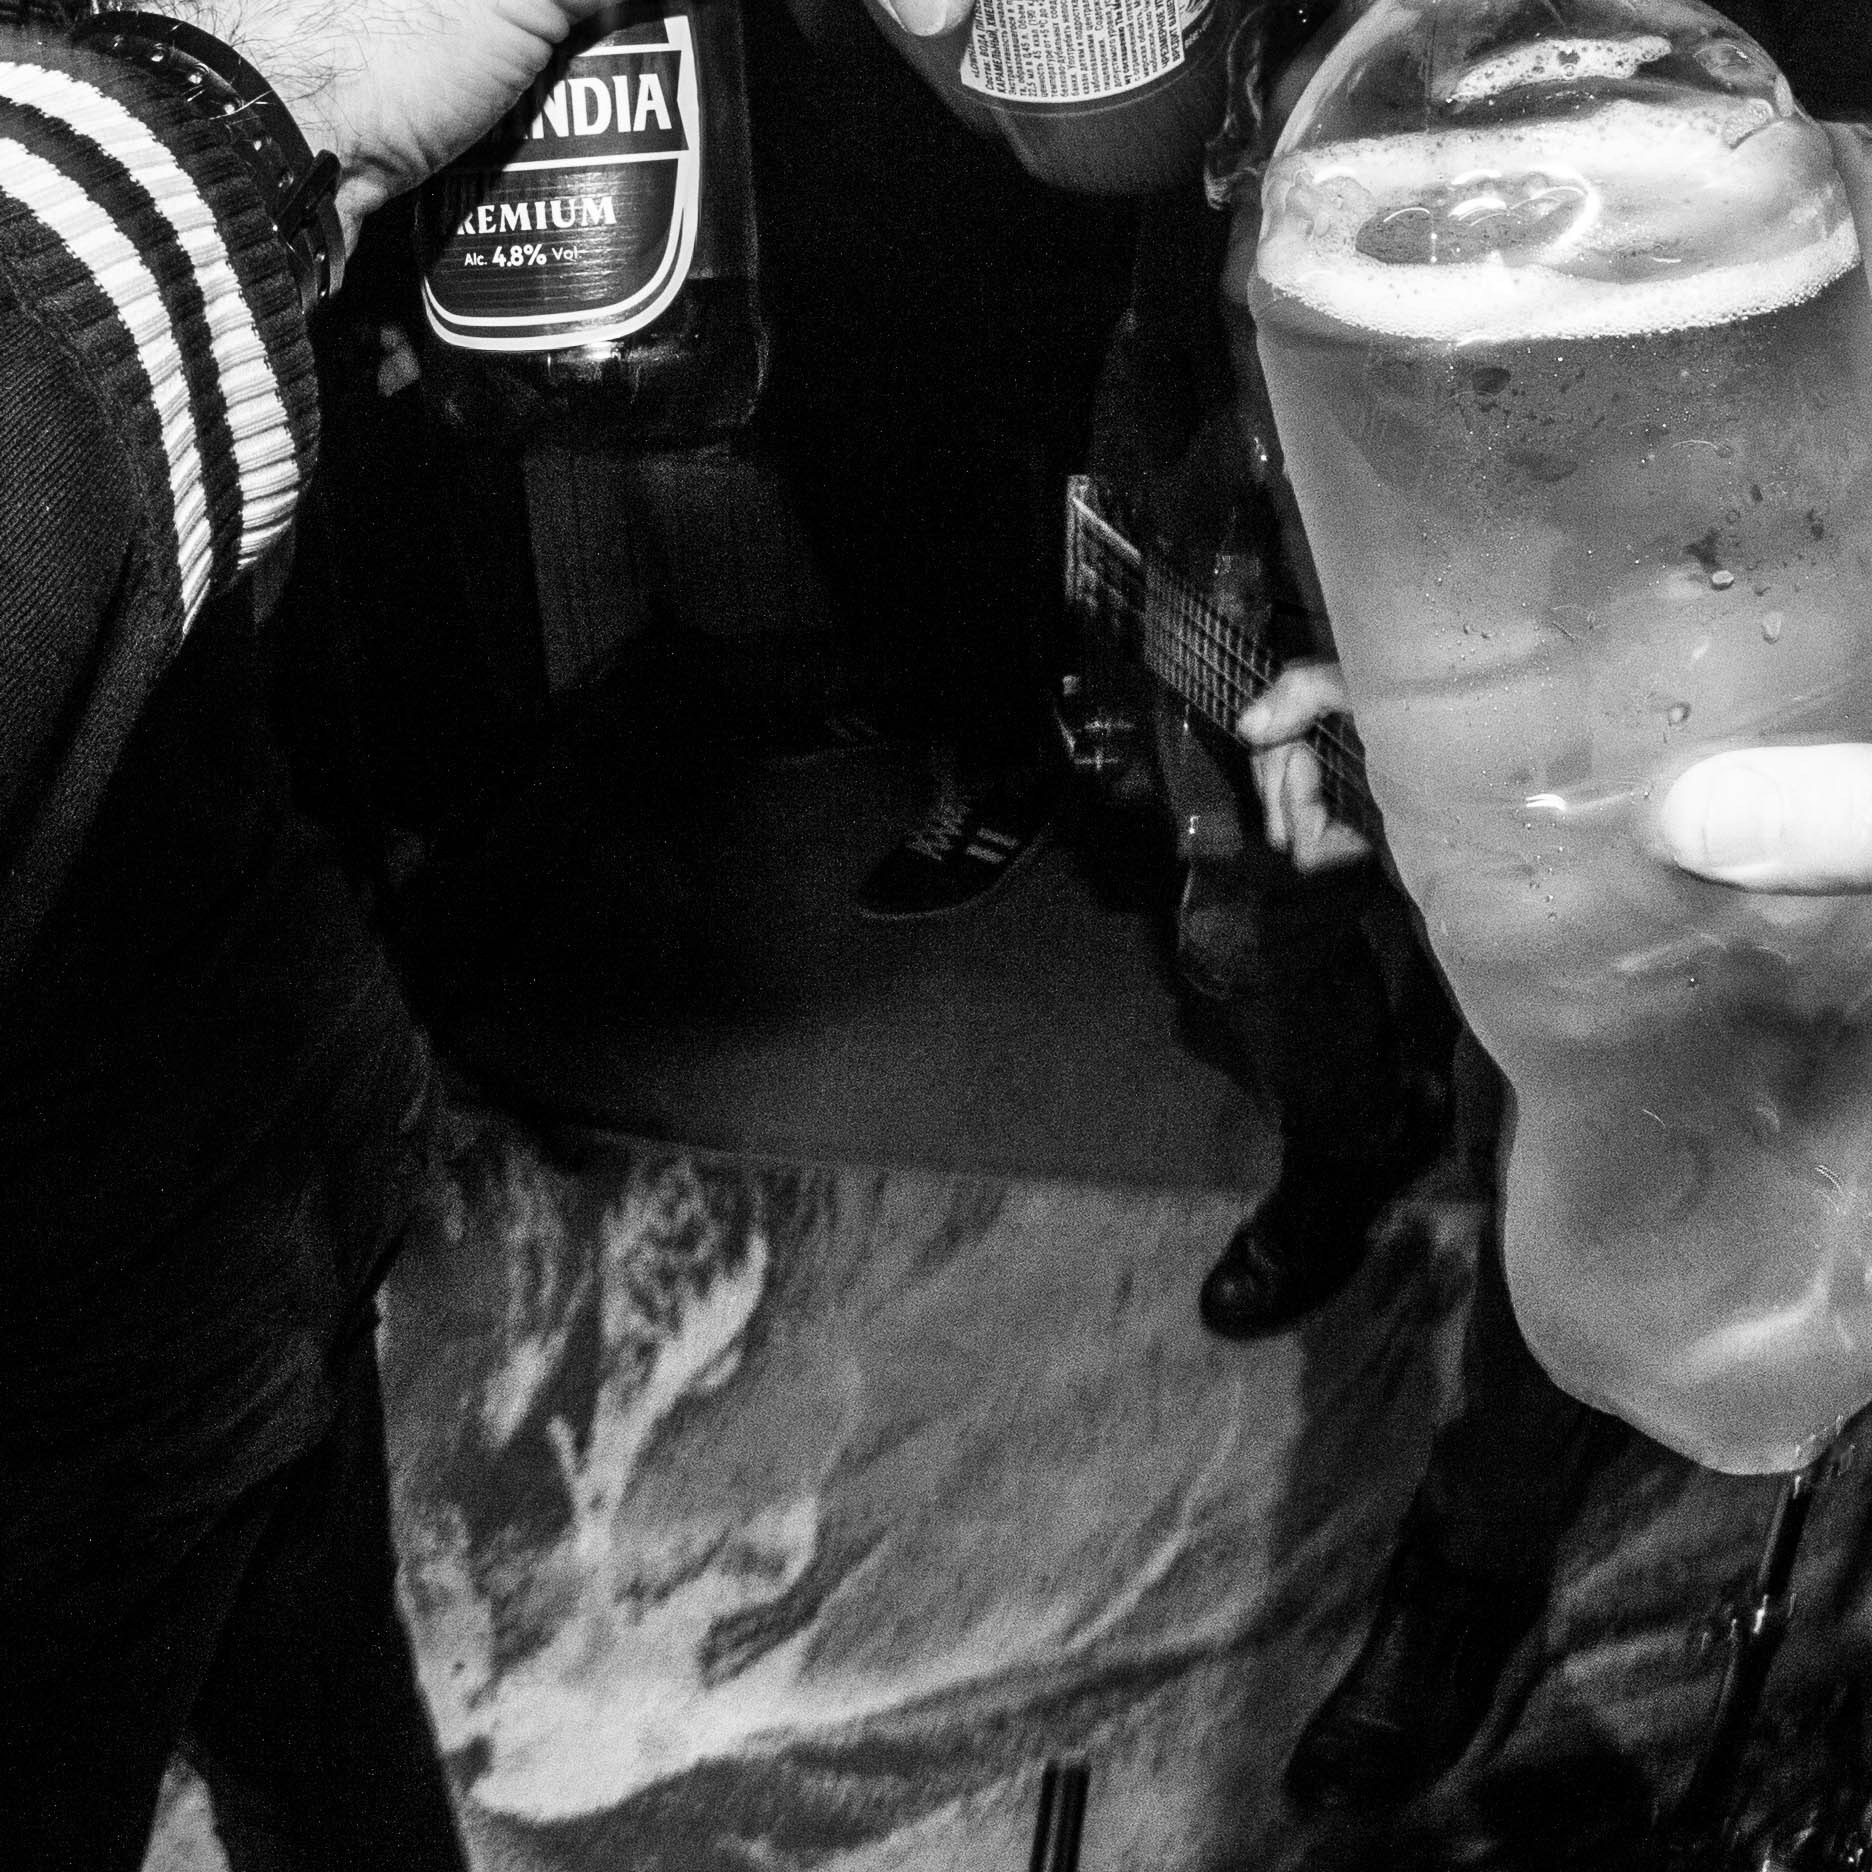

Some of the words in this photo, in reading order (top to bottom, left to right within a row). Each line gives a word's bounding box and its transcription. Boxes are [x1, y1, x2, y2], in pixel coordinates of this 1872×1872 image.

[528, 73, 673, 140] NDIA
[464, 251, 488, 266] Alc.
[491, 243, 547, 268] 4.8%
